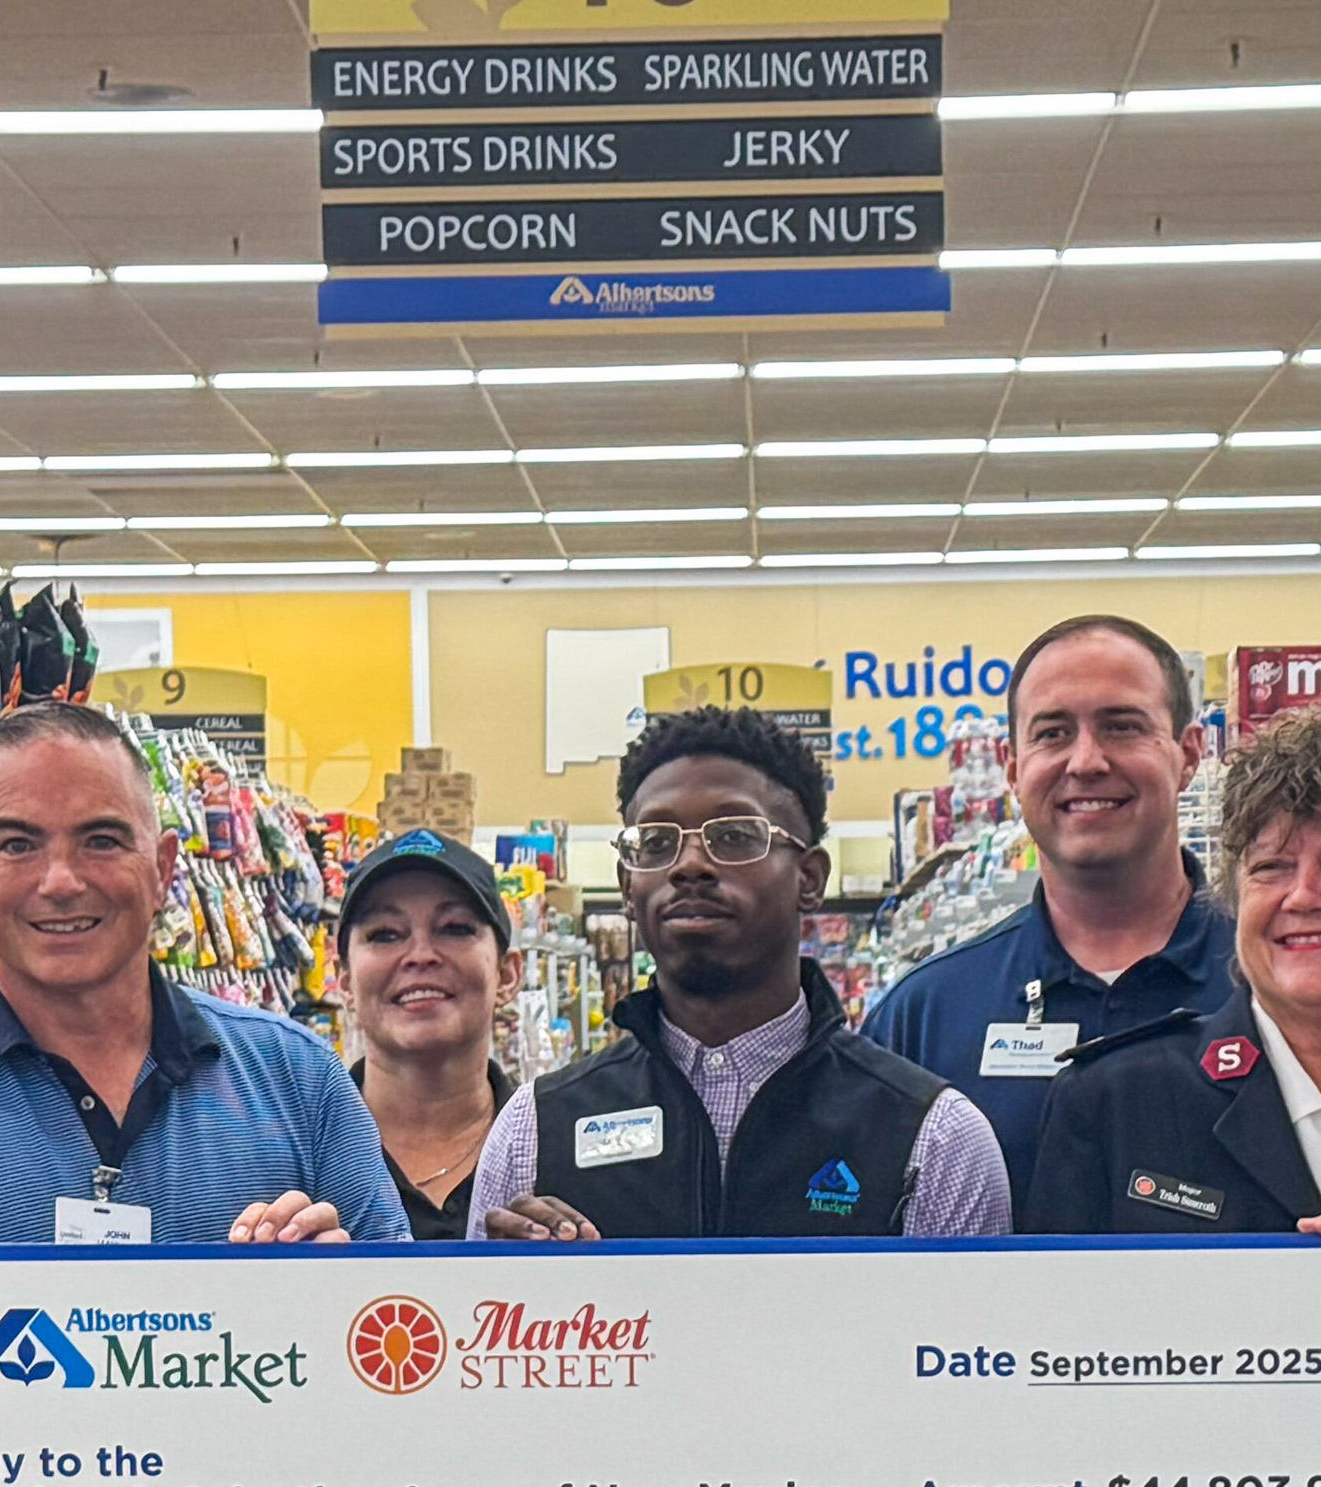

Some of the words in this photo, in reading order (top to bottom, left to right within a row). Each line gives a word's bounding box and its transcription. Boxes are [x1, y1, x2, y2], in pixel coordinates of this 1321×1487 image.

[334, 58, 474, 97] ENERGY
[485, 55, 618, 95] DRINKS
[644, 51, 814, 92] SPARKLING
[822, 48, 929, 87] WATER
[334, 136, 472, 175] SPORTS
[484, 133, 618, 172] DRINKS
[724, 129, 850, 169] JERKY
[380, 213, 576, 252] POPCORN
[660, 208, 797, 247] SNACK
[809, 205, 917, 243] NUTS
[595, 282, 715, 304] Albertsons
[162, 669, 186, 705] 9
[717, 665, 763, 702] 10
[845, 645, 1012, 699] Ruido
[195, 717, 244, 729] CEREAL
[1217, 1042, 1241, 1072] S
[66, 1308, 215, 1332] Albertsons
[456, 1300, 653, 1351] Market
[101, 1331, 308, 1404] Market
[460, 1354, 646, 1388] STREET
[916, 1344, 1016, 1379] Date
[1029, 1348, 1224, 1382] September
[40, 1449, 82, 1477] to
[97, 1446, 164, 1477] the
